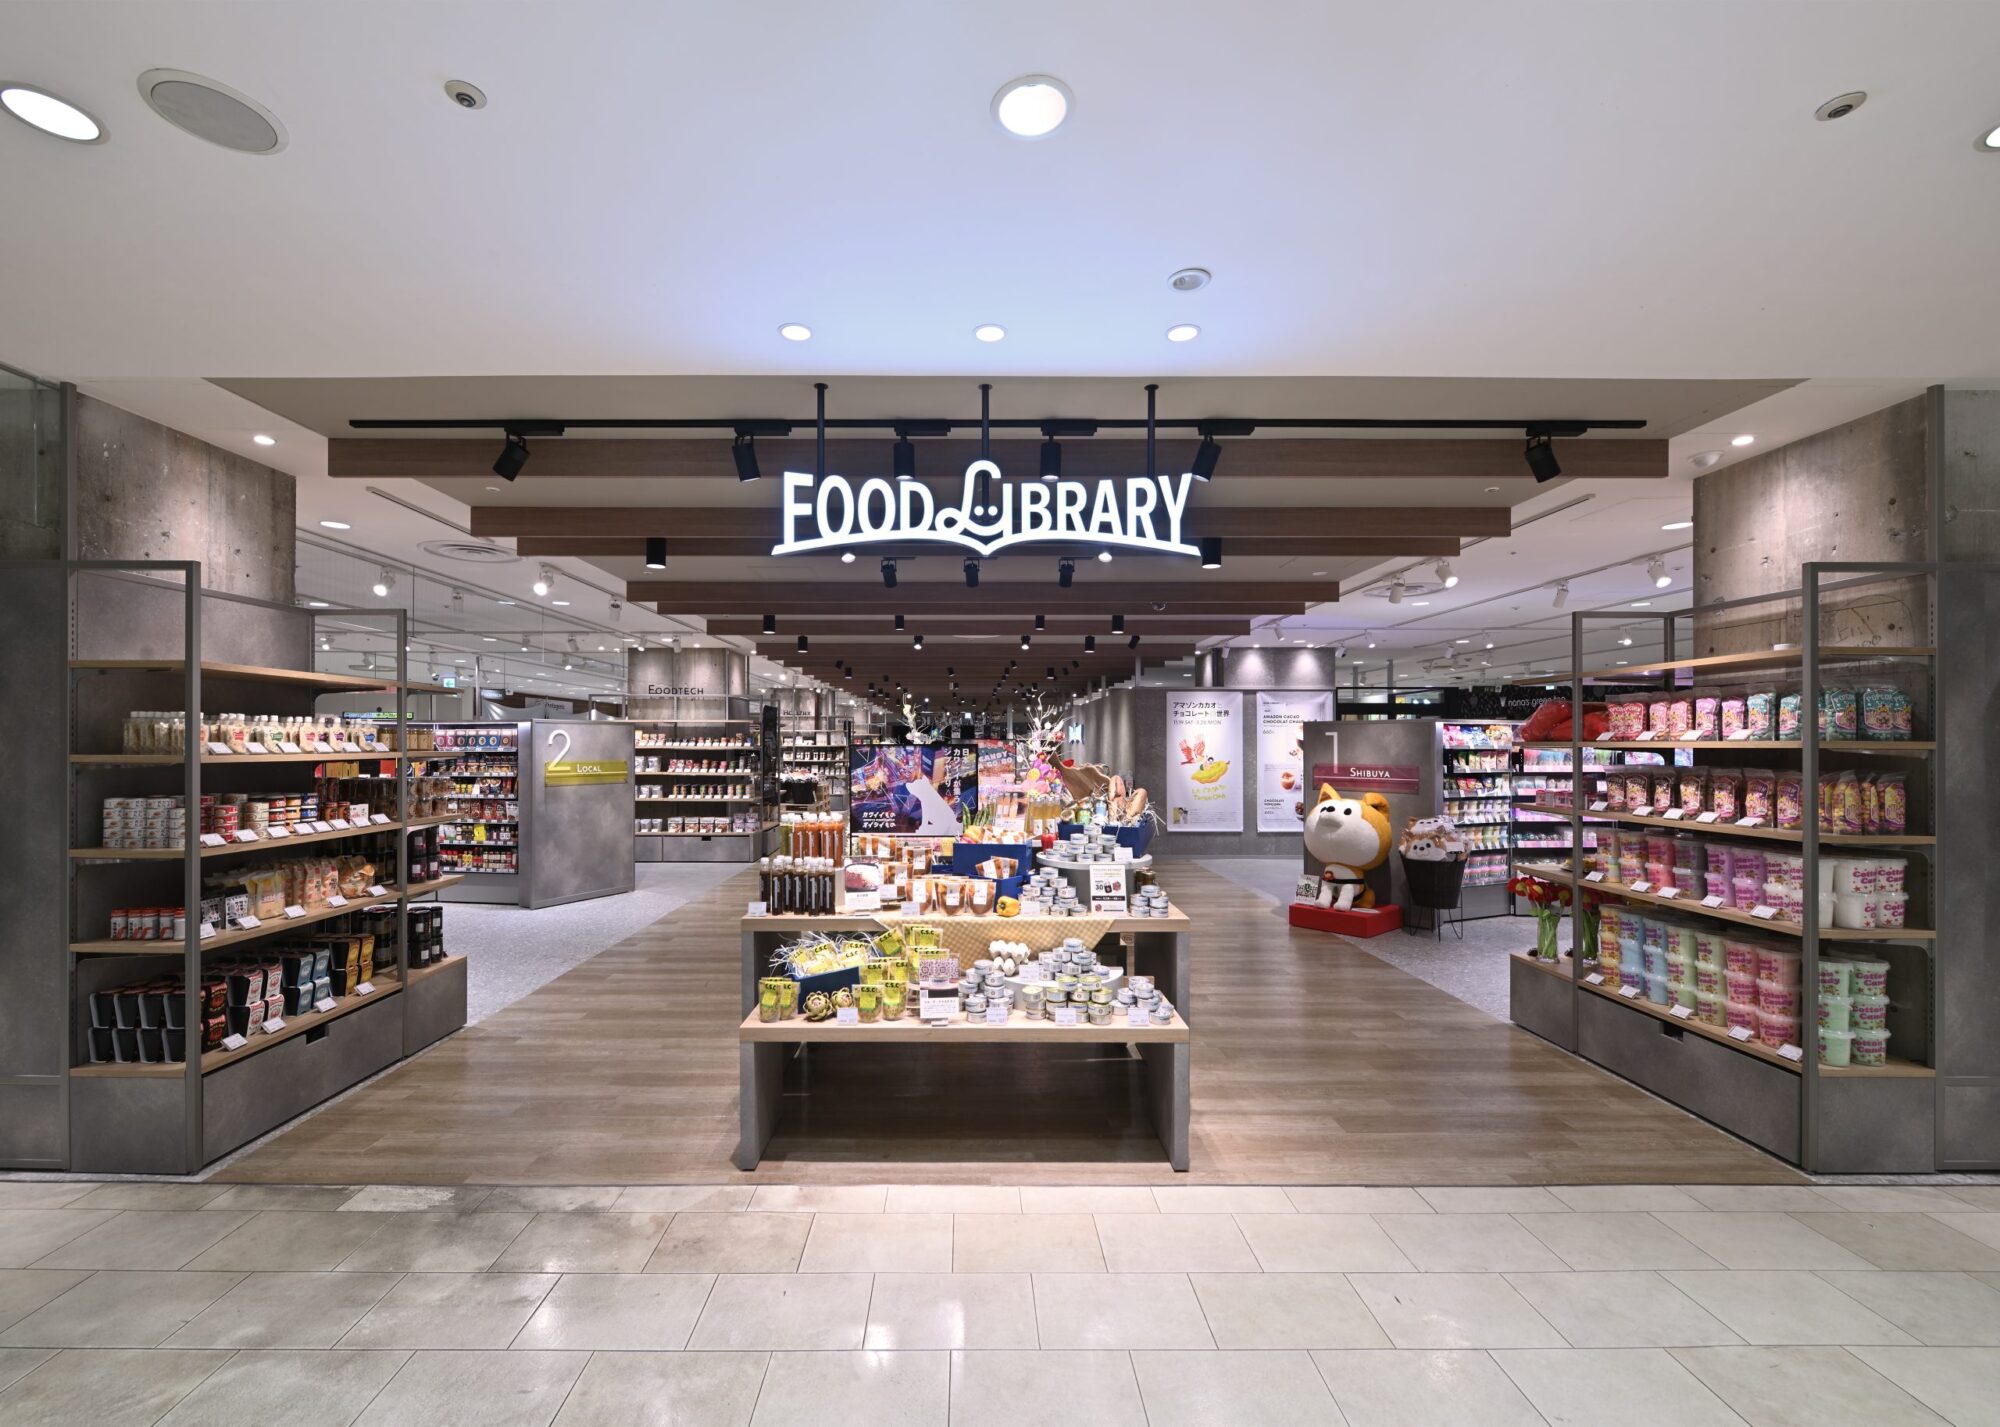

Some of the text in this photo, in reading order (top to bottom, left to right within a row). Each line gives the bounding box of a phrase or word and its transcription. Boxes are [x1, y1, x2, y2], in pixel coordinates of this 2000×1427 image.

[782, 459, 1194, 550] FOOD LIBRARY
[1507, 699, 1530, 707] nana's
[548, 729, 571, 771] 2
[1325, 731, 1338, 774] 1
[576, 764, 602, 773] LOCAL
[1350, 767, 1391, 778] SHIBUYA
